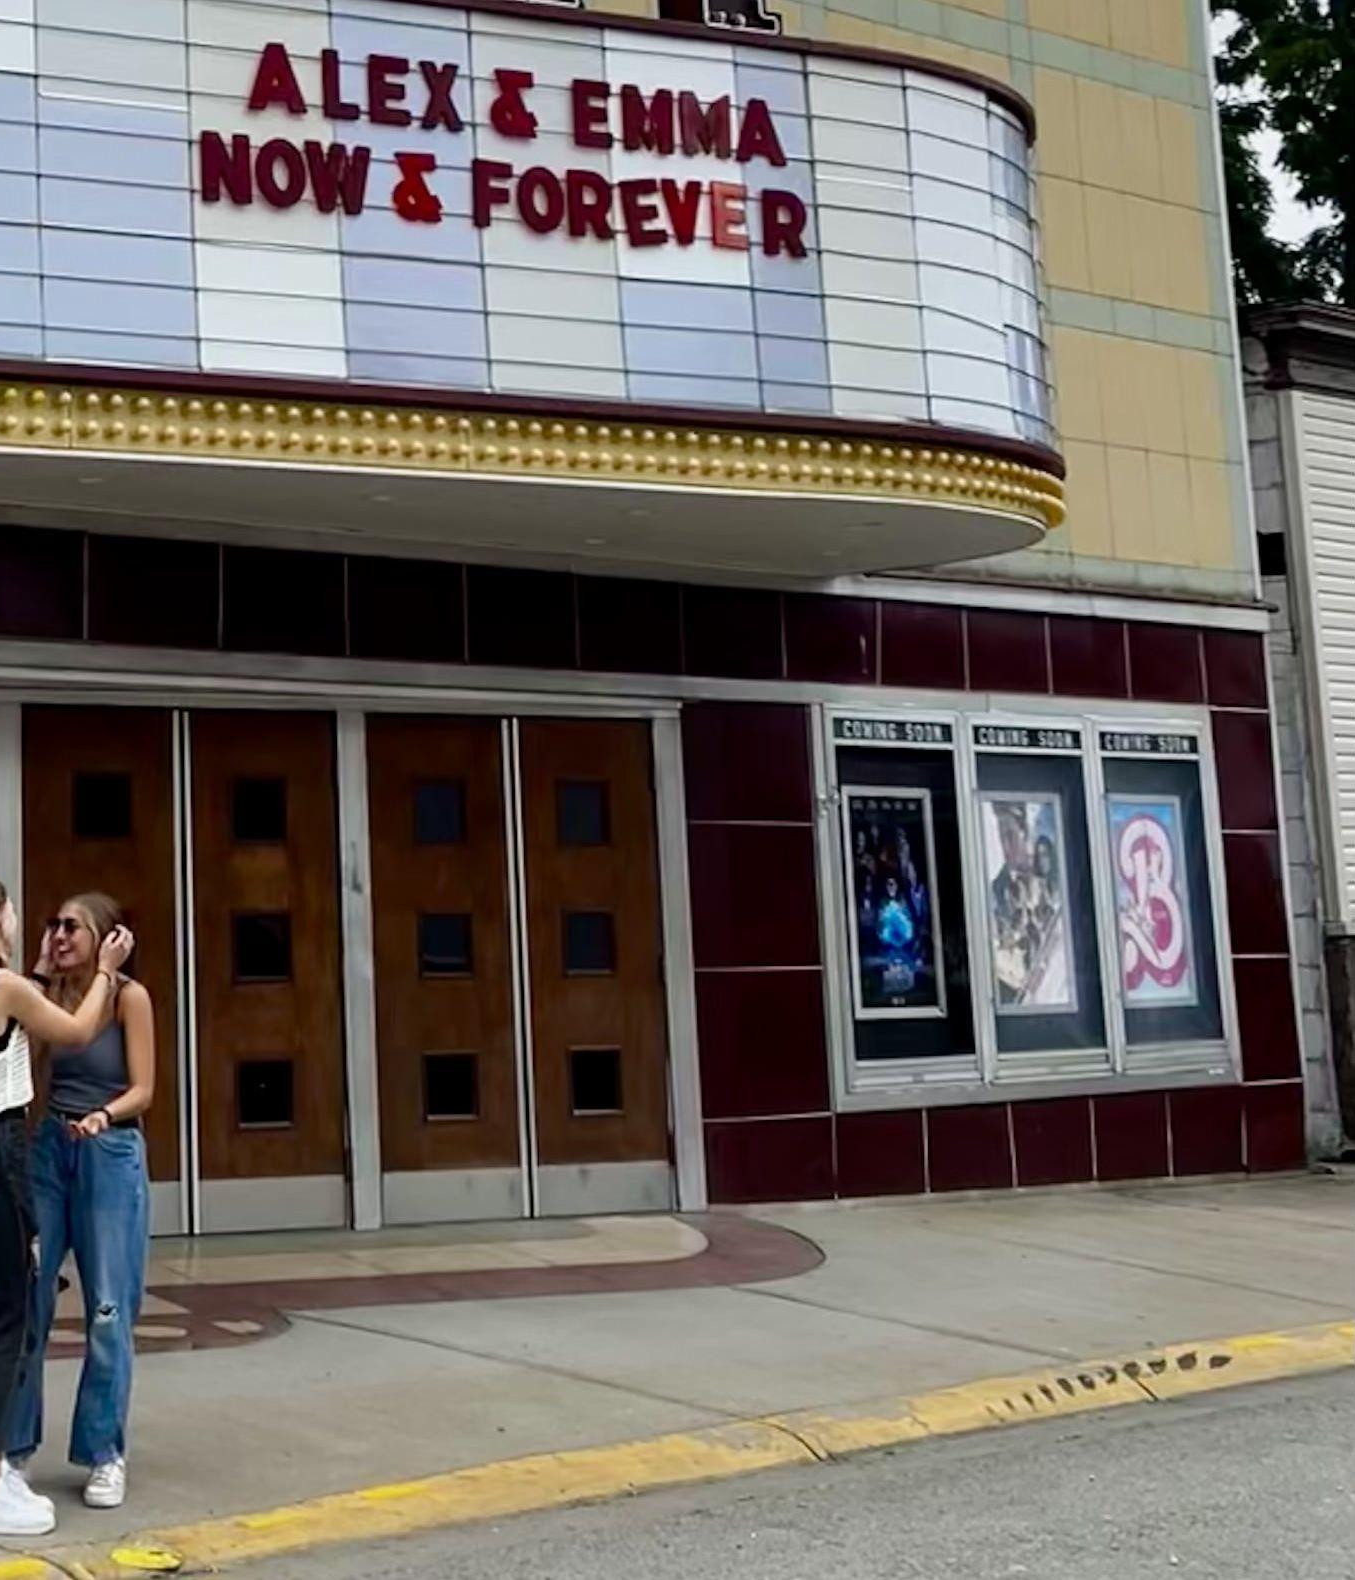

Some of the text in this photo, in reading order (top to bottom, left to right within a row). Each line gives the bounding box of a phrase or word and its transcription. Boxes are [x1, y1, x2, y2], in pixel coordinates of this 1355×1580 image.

[248, 42, 788, 168] ALEX & EMMA
[199, 130, 808, 259] NOW & FOREVER
